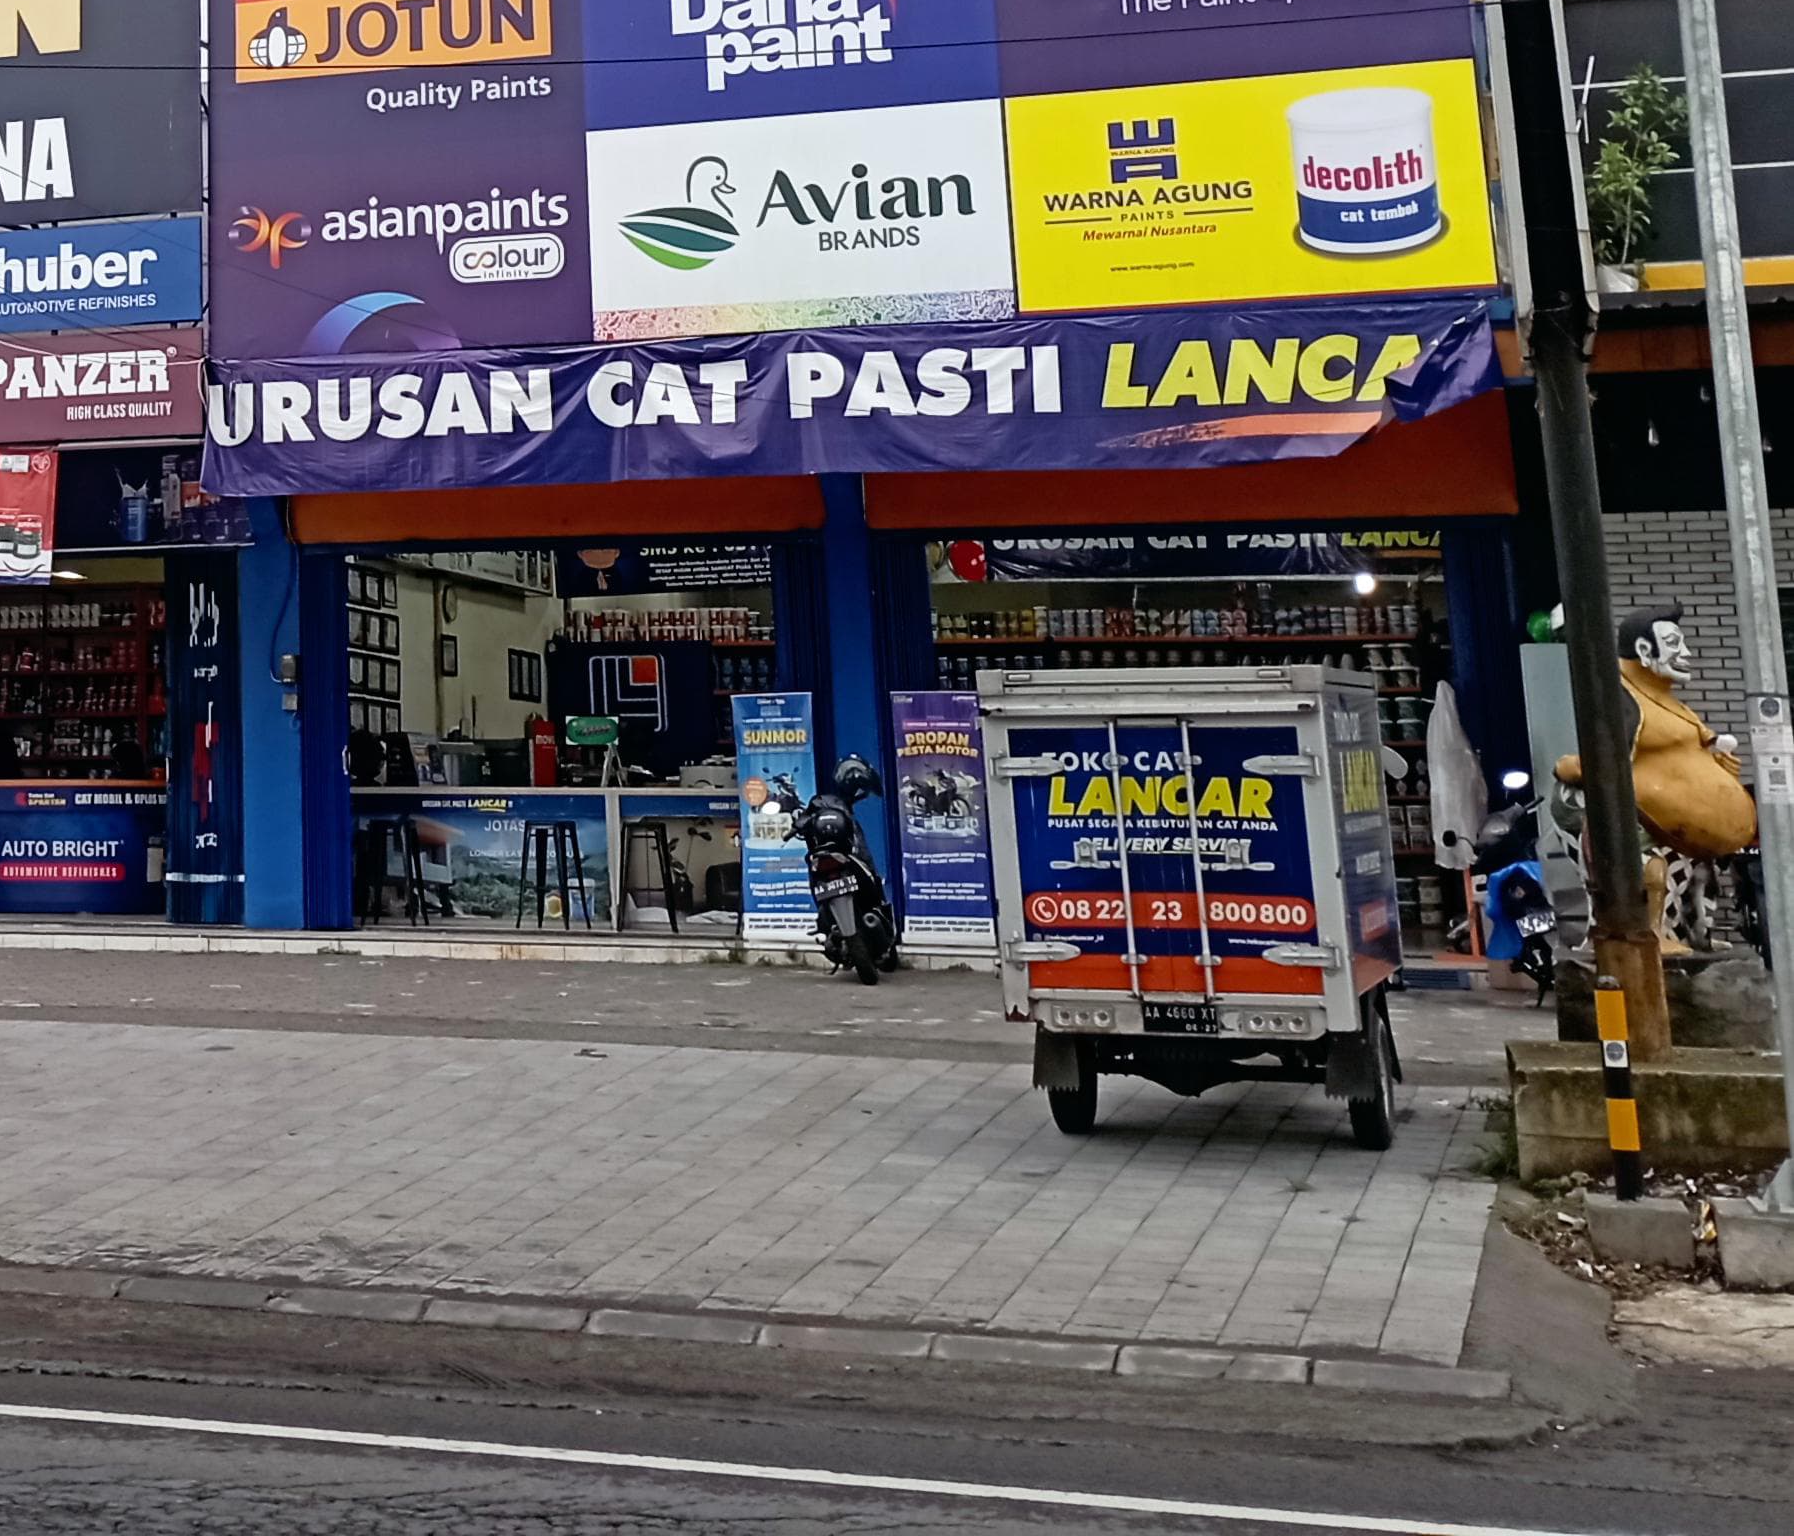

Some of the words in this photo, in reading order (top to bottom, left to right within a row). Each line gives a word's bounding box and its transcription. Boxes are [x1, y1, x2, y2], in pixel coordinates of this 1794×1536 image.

[705, 4, 893, 92] paint
[366, 80, 462, 113] Quality
[470, 74, 552, 103] Paints
[1302, 149, 1424, 192] decolith
[756, 163, 976, 228] Avian
[1043, 191, 1145, 214] WARNA
[1152, 180, 1253, 206] AGUNG
[321, 188, 569, 255] asianpaints
[1120, 210, 1175, 222] PAINTS
[1340, 208, 1365, 223] cat
[1370, 201, 1420, 222] tembok
[819, 226, 921, 251] BRANDS
[1082, 225, 1148, 242] Mewarnai
[1150, 222, 1218, 238] Nusantara
[462, 243, 551, 271] colour
[483, 268, 531, 280] infinity
[78, 293, 157, 311] REFINISHES
[208, 366, 557, 447] URUSAN
[586, 356, 742, 428] CAT
[787, 344, 1062, 421] PASTI
[66, 406, 92, 422] HIGH
[93, 403, 125, 420] CLASS
[127, 401, 173, 419] QUALITY
[742, 729, 807, 745] SUNMOR
[904, 730, 970, 747] PROPAN
[896, 745, 934, 758] PESTA
[934, 744, 980, 759] MOTOR
[74, 793, 92, 805] CAT
[93, 793, 123, 805] MOBIL
[467, 798, 507, 809] LANCAR
[1048, 775, 1274, 819] LANCAR
[1047, 819, 1085, 829] PUSAT
[1088, 818, 1134, 829] SEGAA
[1136, 818, 1213, 830] KEBUTUAN
[1216, 820, 1239, 830] CAT
[1241, 821, 1279, 832] ANDA
[1, 840, 48, 858] AUTO
[52, 840, 120, 858] BRIGHT
[1172, 837, 1251, 852] SERVI
[1060, 900, 1091, 920] 08
[1096, 900, 1126, 920] 22
[1151, 901, 1183, 921] 23
[1144, 1006, 1162, 1020] AA
